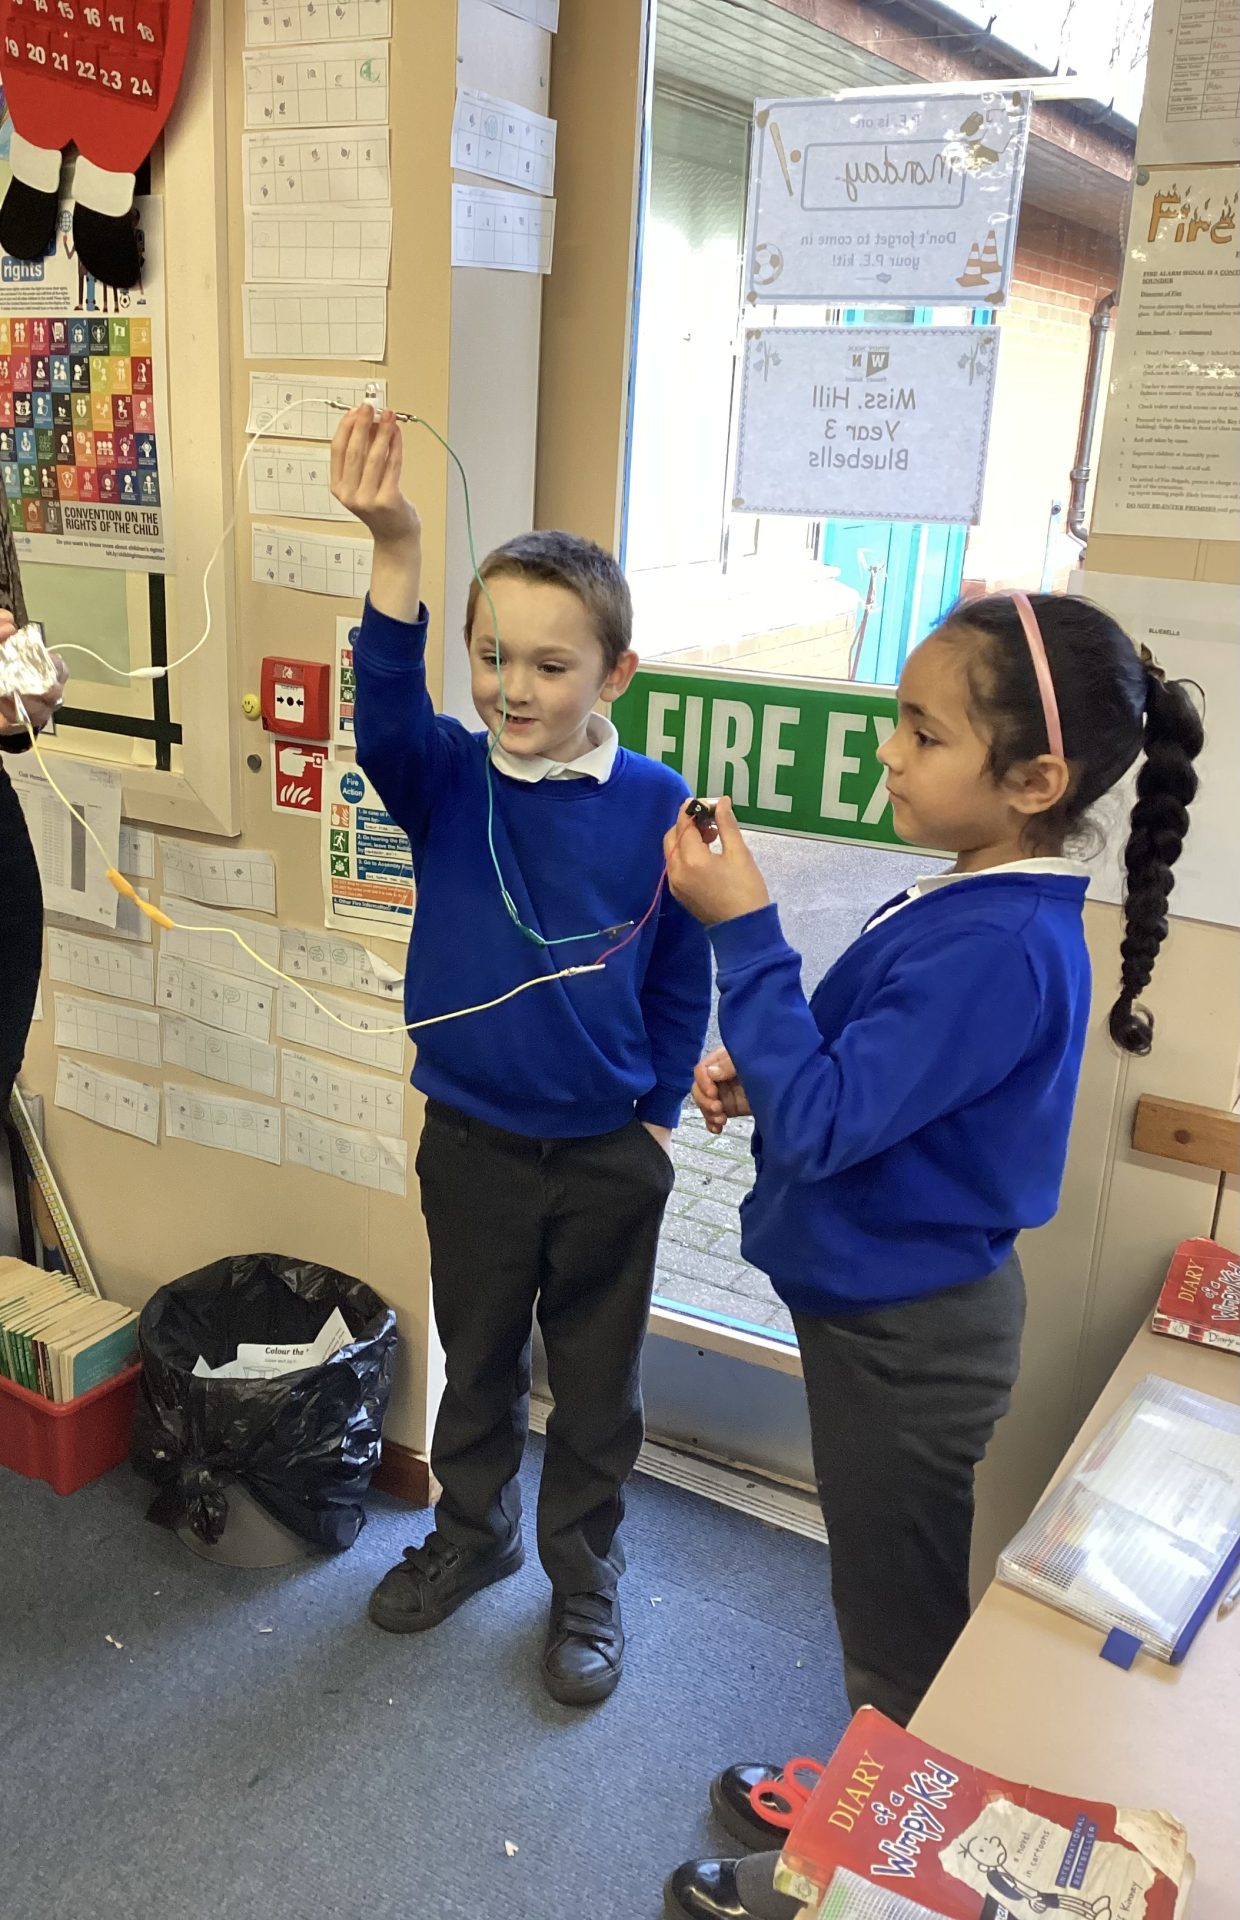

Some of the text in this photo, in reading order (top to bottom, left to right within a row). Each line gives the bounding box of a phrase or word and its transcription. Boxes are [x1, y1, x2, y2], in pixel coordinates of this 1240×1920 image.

[34, 0, 155, 42] 14 15 16 17 18
[5, 36, 153, 96] 19 20 21 22 23 24
[1147, 189, 1236, 245] Fire
[3, 260, 43, 281] rights
[64, 507, 158, 525] CONVENTION ON THE
[65, 519, 160, 537] RIGHTS OF THE CHILD
[645, 691, 897, 825] FIRE EX
[342, 787, 363, 797] Action
[346, 777, 359, 786] Fire
[1178, 1258, 1205, 1303] DIARY
[265, 1346, 304, 1356] Colour the
[827, 1749, 885, 1833] DIARY
[871, 1790, 905, 1826] of a
[870, 1759, 959, 1878] Wimpy Kid
[1018, 1831, 1032, 1856] novel
[1032, 1830, 1051, 1867] cartoons
[1058, 1816, 1086, 1885] INTERNATIONAL
[1072, 1826, 1096, 1885] BESTSELLER
[1119, 1880, 1143, 1913] Kinney
